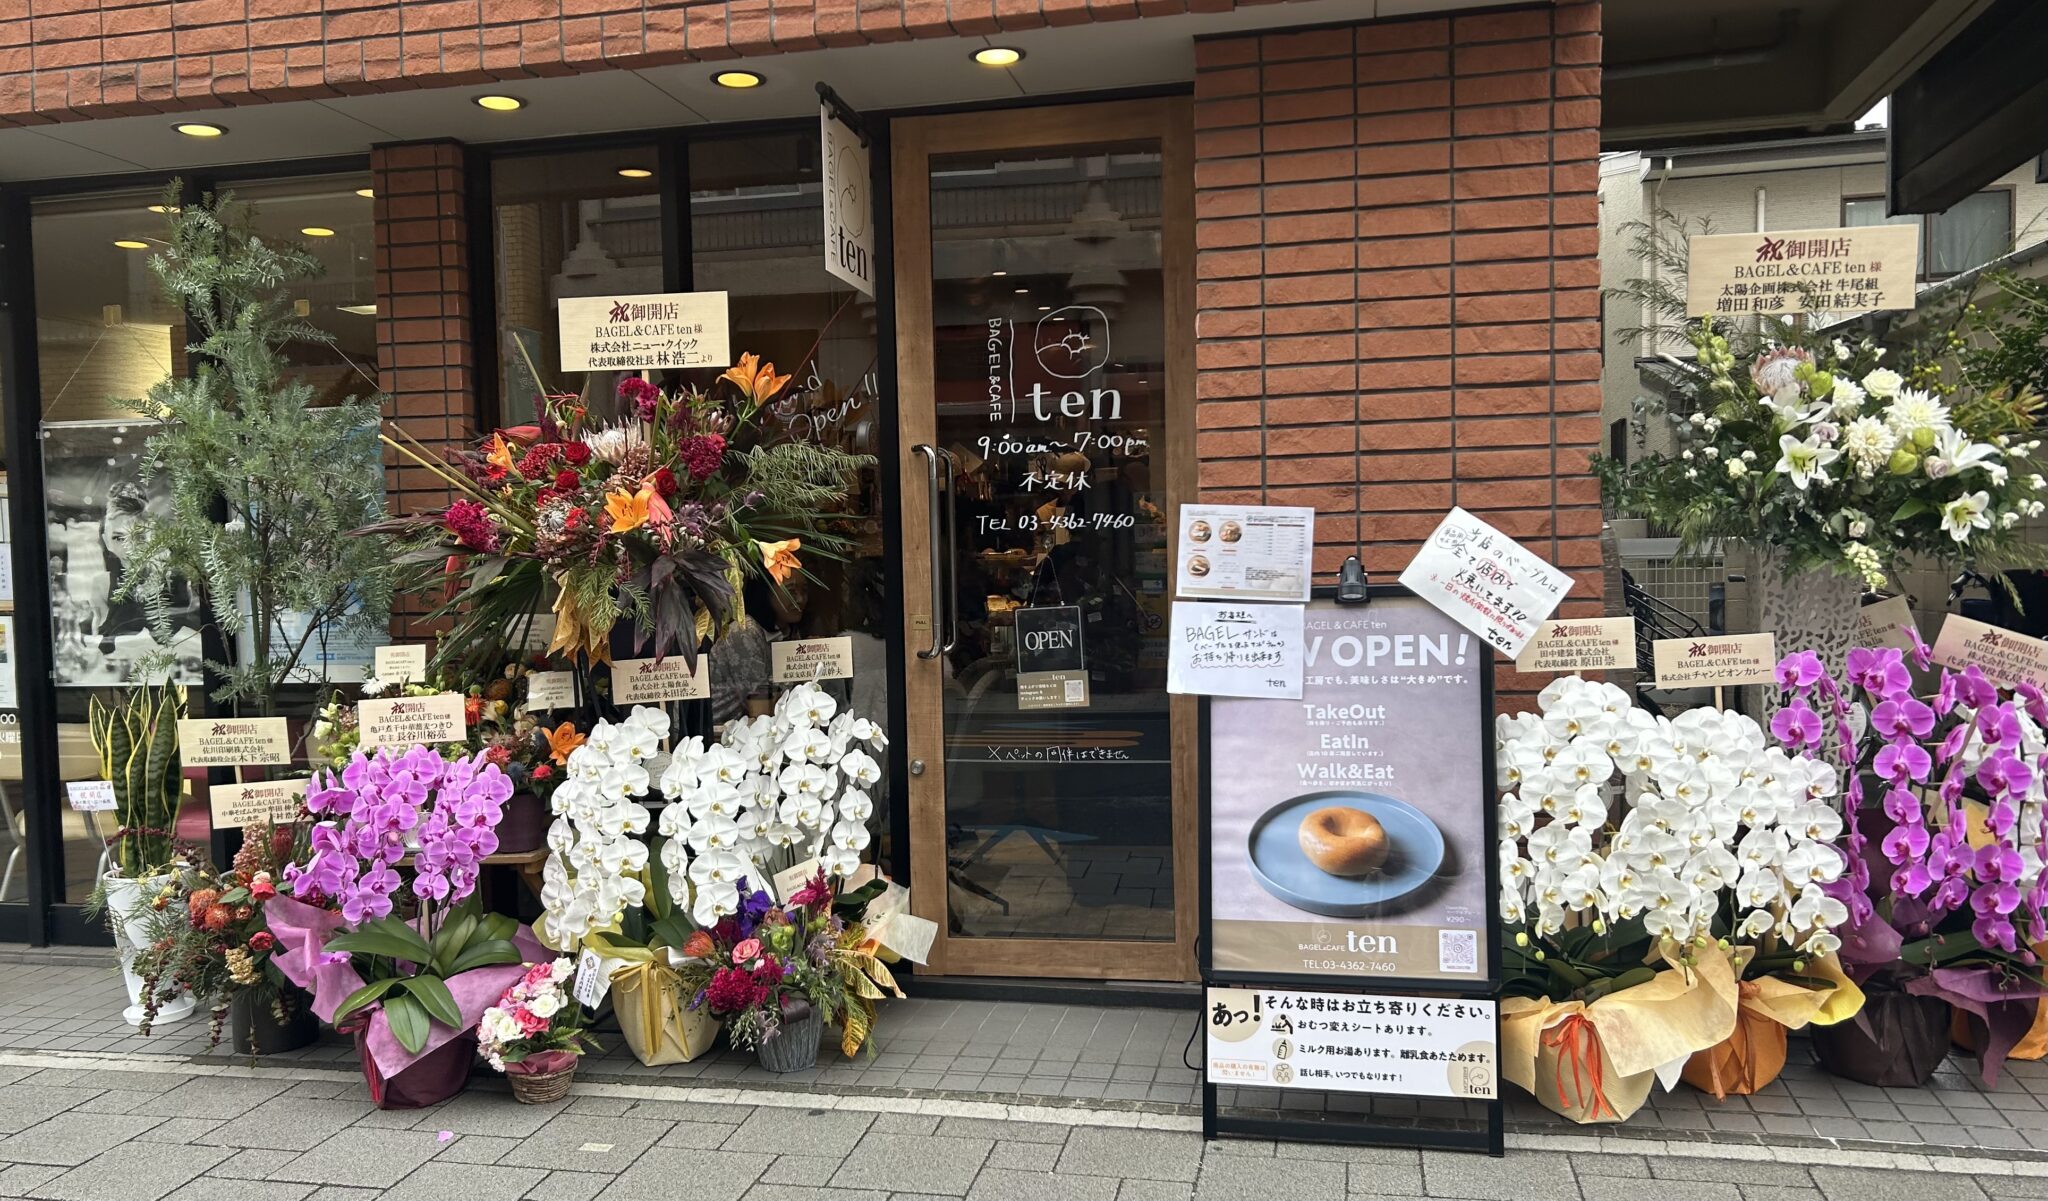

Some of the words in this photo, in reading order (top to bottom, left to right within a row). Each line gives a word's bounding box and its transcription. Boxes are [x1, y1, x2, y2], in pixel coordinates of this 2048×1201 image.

[837, 225, 869, 282] ten
[1755, 236, 1852, 263] 祝御開店
[1734, 262, 1843, 279] BAGEL&CAFE
[1844, 262, 1866, 274] ten
[1869, 260, 1882, 273] 様
[608, 300, 680, 324] 祝御開店
[595, 324, 675, 338] BAGEL&CAFE
[676, 325, 693, 335] ten
[987, 317, 1003, 423] BAGEL&CAFE
[1024, 383, 1122, 422] ten
[1019, 470, 1092, 493] 不定休
[975, 515, 1012, 535] TEL
[1018, 512, 1135, 531] 03-4362-7460
[1343, 620, 1369, 630] CAFE
[1370, 620, 1387, 630] ten
[1551, 624, 1603, 638] 祝御開店
[1873, 625, 1888, 635] ten
[1024, 629, 1074, 651] OPEN
[1186, 625, 1240, 643] BAGEL
[1486, 626, 1513, 651] ten
[1330, 633, 1470, 668] OPEN!
[1537, 638, 1599, 649] BAGEL&CAFE
[1688, 641, 1743, 658] 祝御開店
[786, 653, 828, 663] BAGEL&CAFE
[1677, 657, 1739, 669] BAGEL&CAFE
[1963, 639, 2033, 667] BAGEL&CAFE
[2033, 662, 2048, 672] ten
[629, 672, 679, 683] BAGEL&CAFE
[1265, 678, 1287, 688] ten
[378, 713, 433, 724] BAGEL&CAFE
[1303, 703, 1386, 720] TakeOut
[199, 737, 255, 746] BAGEL&CAFE
[1320, 734, 1369, 749] EatIn
[1296, 763, 1395, 780] Walk&Eat
[232, 799, 282, 808] BAGEL&CAFE
[1298, 943, 1346, 952] BAGEL&CAFE
[1345, 929, 1399, 954] ten
[1302, 959, 1396, 972] TEL:03-4362-7460
[1265, 995, 1491, 1020] そんな時はお立ち寄りください。
[1297, 1020, 1433, 1036] おむつ変えシートあります。
[1469, 1084, 1491, 1095] ten
